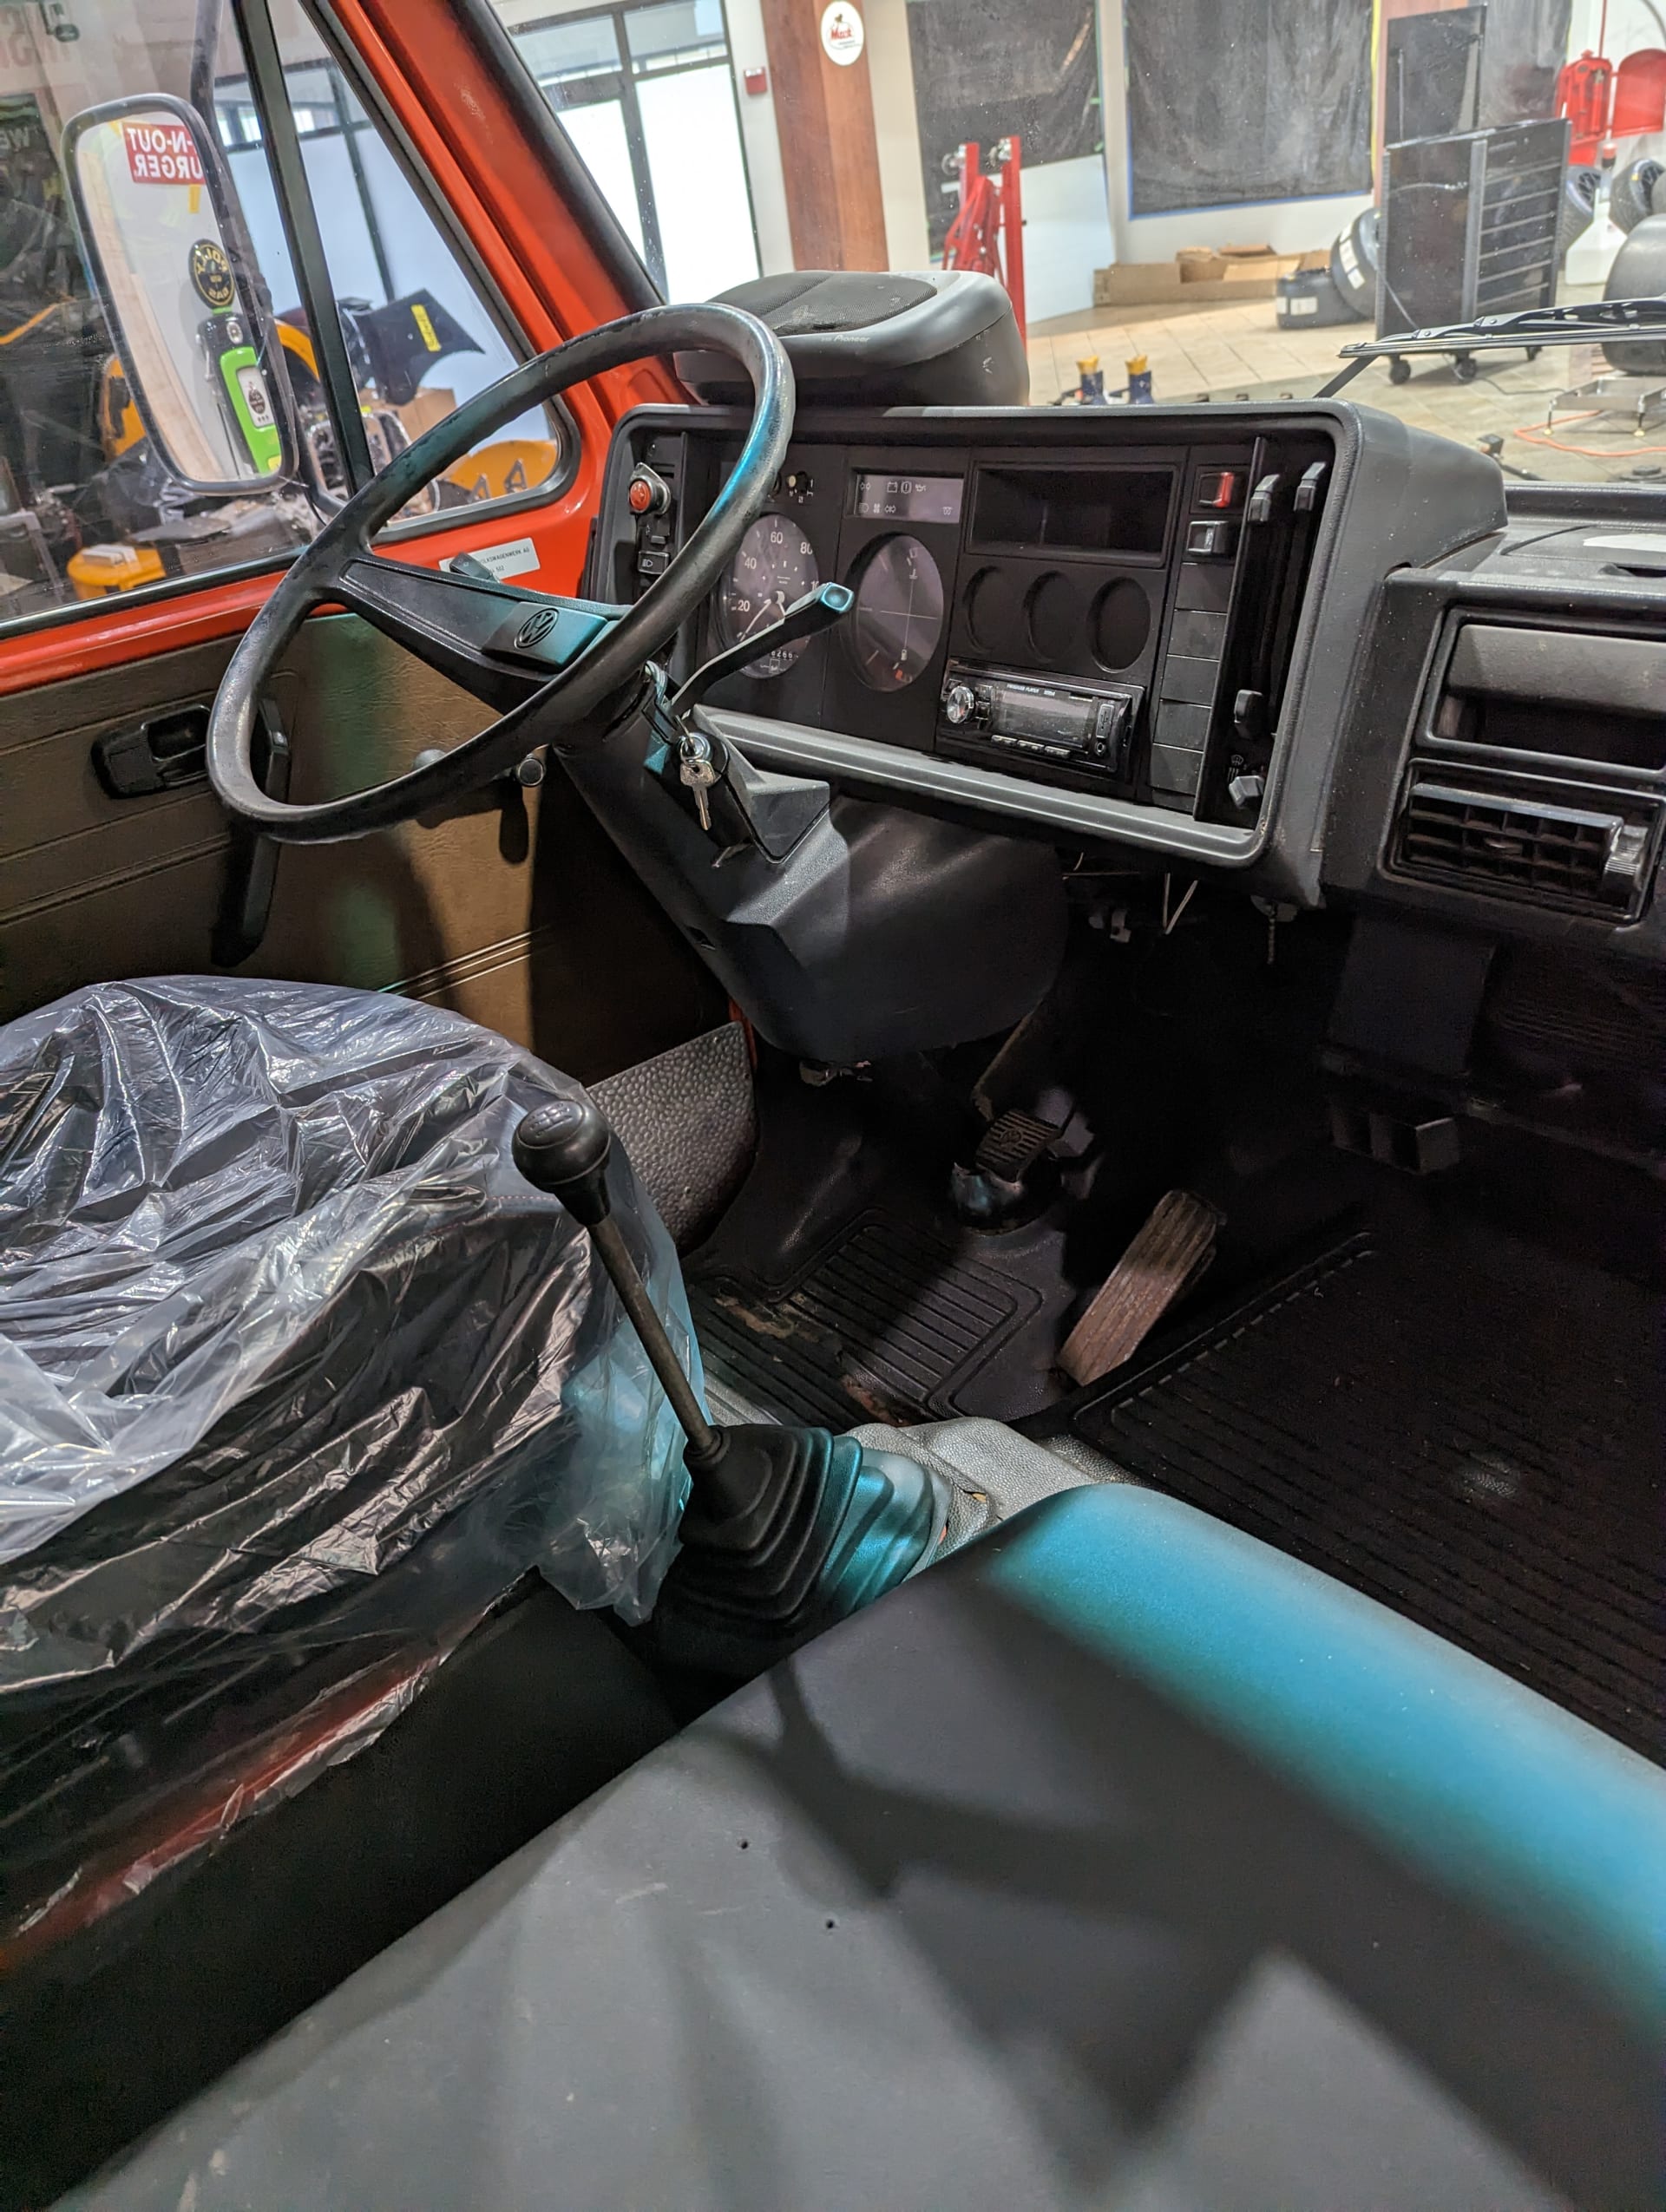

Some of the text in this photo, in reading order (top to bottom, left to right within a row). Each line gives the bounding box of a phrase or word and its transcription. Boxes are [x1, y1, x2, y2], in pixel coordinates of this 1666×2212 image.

[771, 532, 784, 544] 60
[744, 558, 757, 569] 40
[738, 600, 750, 612] 20
